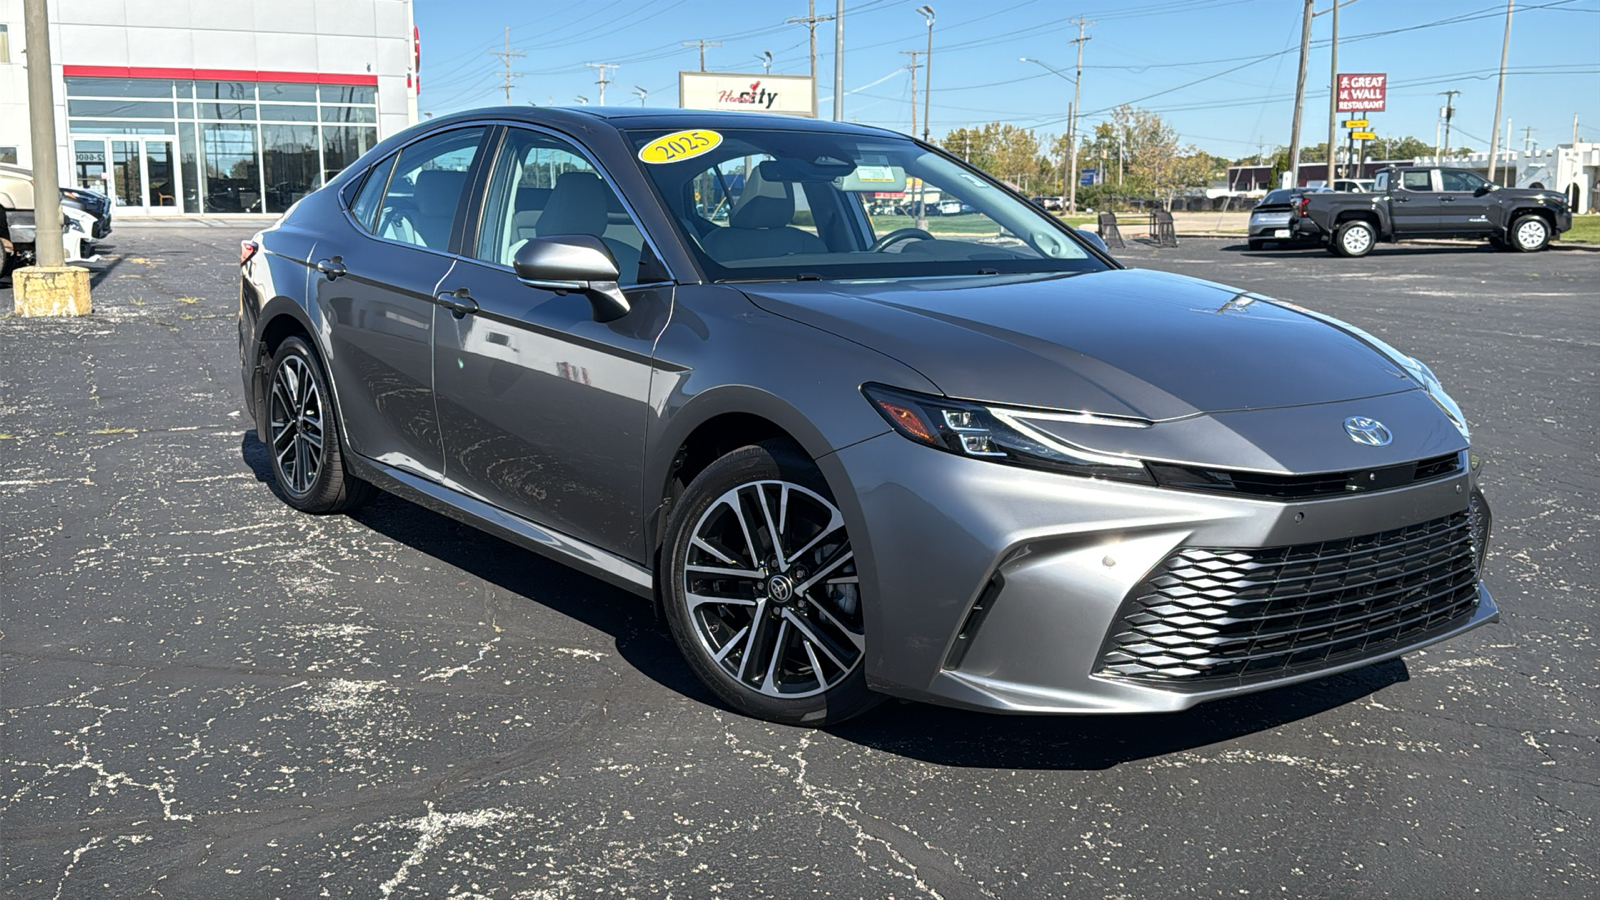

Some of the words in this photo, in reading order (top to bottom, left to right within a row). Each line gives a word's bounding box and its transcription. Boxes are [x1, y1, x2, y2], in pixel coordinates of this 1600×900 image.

[1351, 76, 1385, 88] GREAT
[1351, 88, 1383, 100] WALL
[1338, 100, 1385, 110] RESTAURANT
[656, 132, 710, 160] 2025
